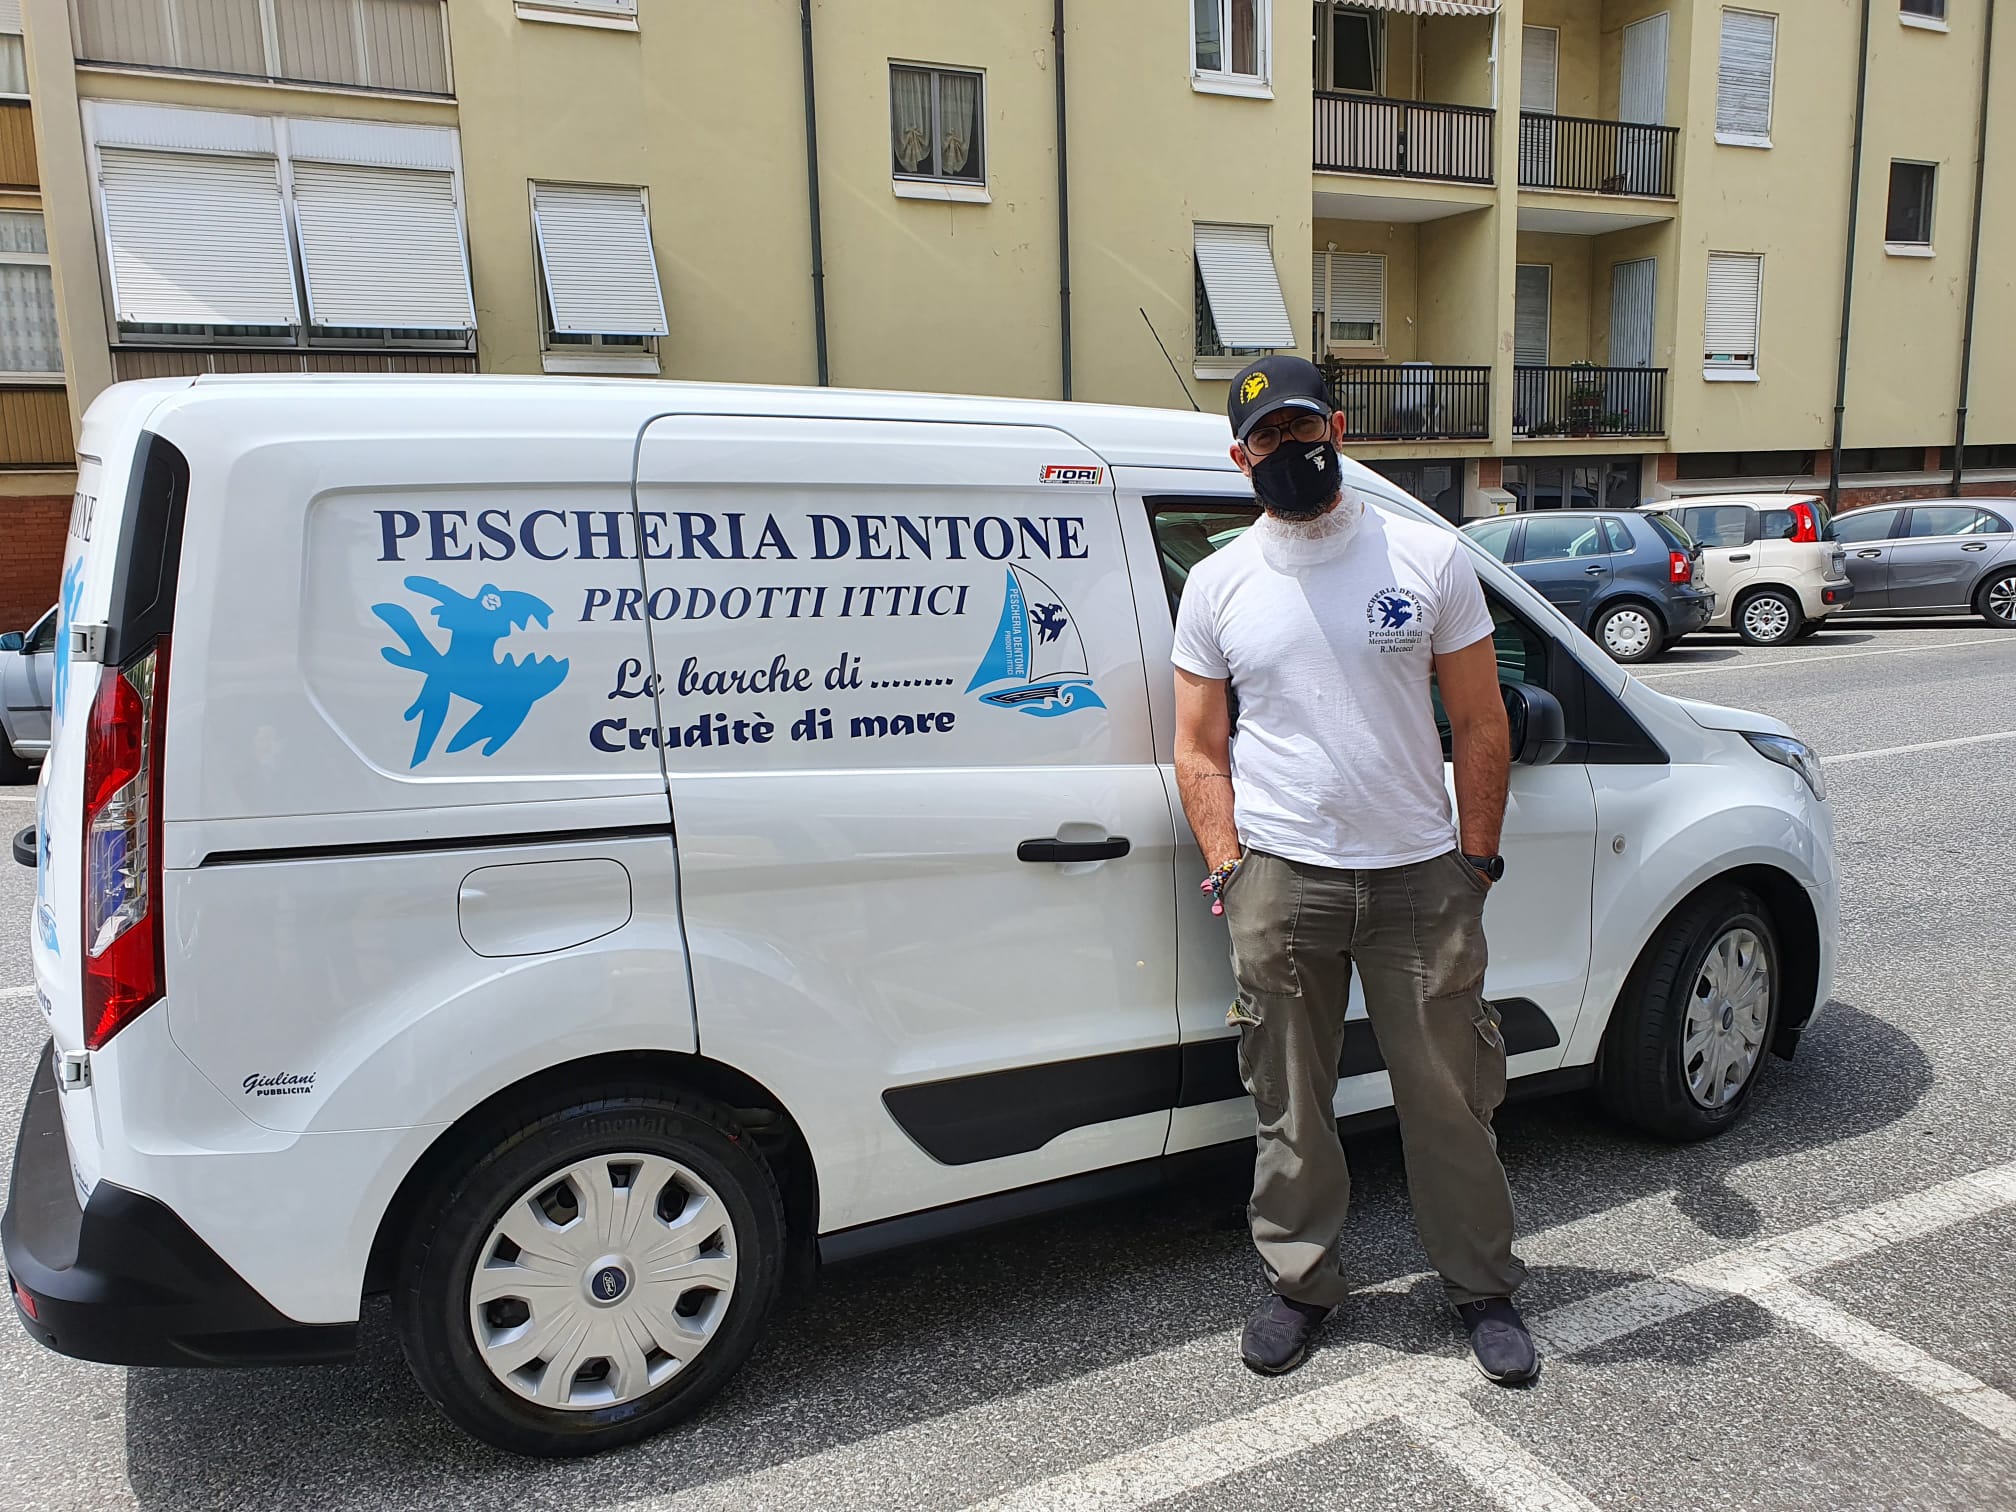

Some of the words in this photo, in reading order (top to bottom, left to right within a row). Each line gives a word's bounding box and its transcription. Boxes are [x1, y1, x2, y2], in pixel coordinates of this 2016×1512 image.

[1044, 465, 1097, 479] FIORI
[373, 508, 798, 562] PESCHERIA
[806, 513, 1090, 561] DENTONE
[578, 586, 829, 622] PRODOTTI
[837, 584, 971, 618] ITTICI
[1009, 588, 1022, 635] PESCHERIA
[1366, 587, 1397, 624] PESCHERIA
[1368, 629, 1405, 638] Prodotti
[1013, 636, 1025, 676] DENTONE
[607, 657, 665, 700] Le
[677, 652, 813, 698] barche
[790, 706, 834, 742] di
[850, 711, 956, 740] mare
[242, 1071, 317, 1095] Giuliani
